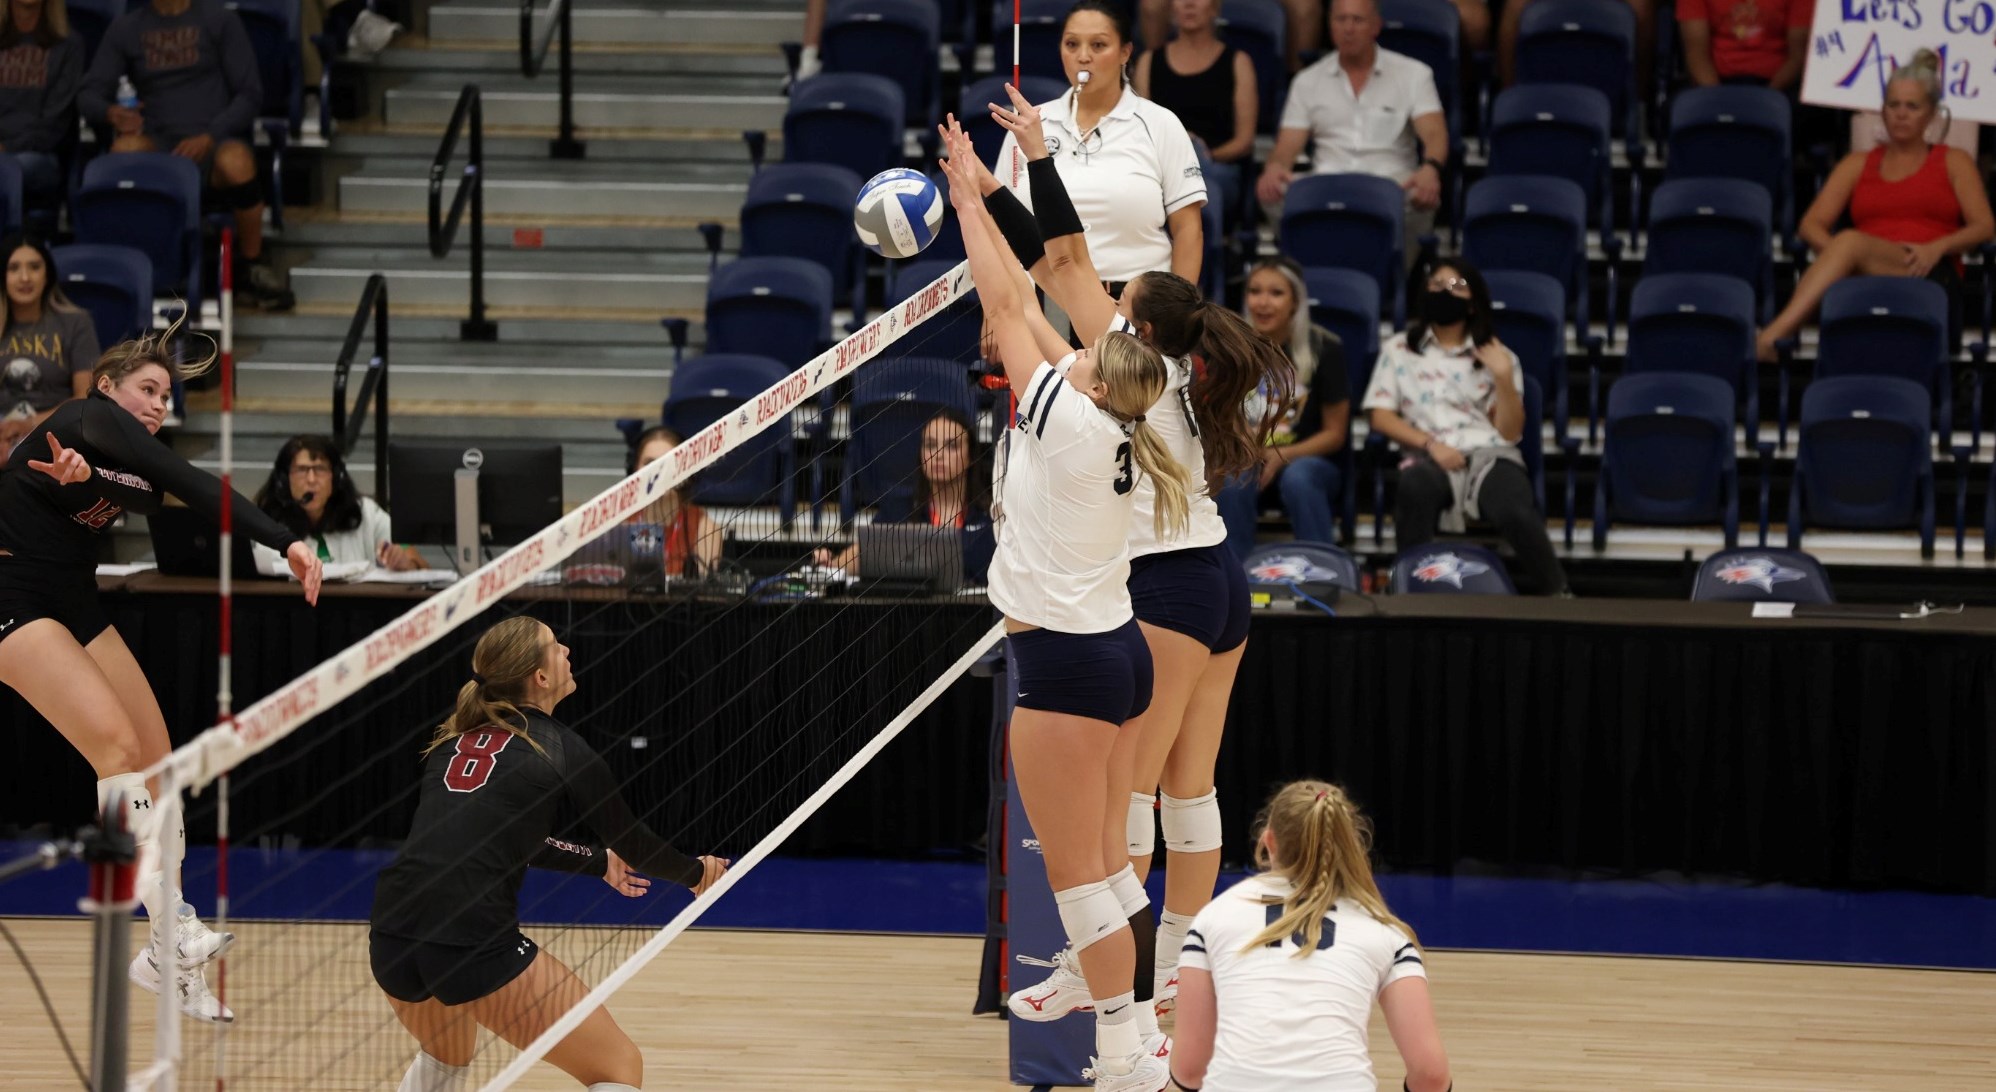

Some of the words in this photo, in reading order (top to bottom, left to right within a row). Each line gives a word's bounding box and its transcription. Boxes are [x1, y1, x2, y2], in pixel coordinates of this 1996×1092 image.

[1815, 30, 1845, 58] #4
[1113, 441, 1133, 496] 3
[443, 726, 515, 793] 8
